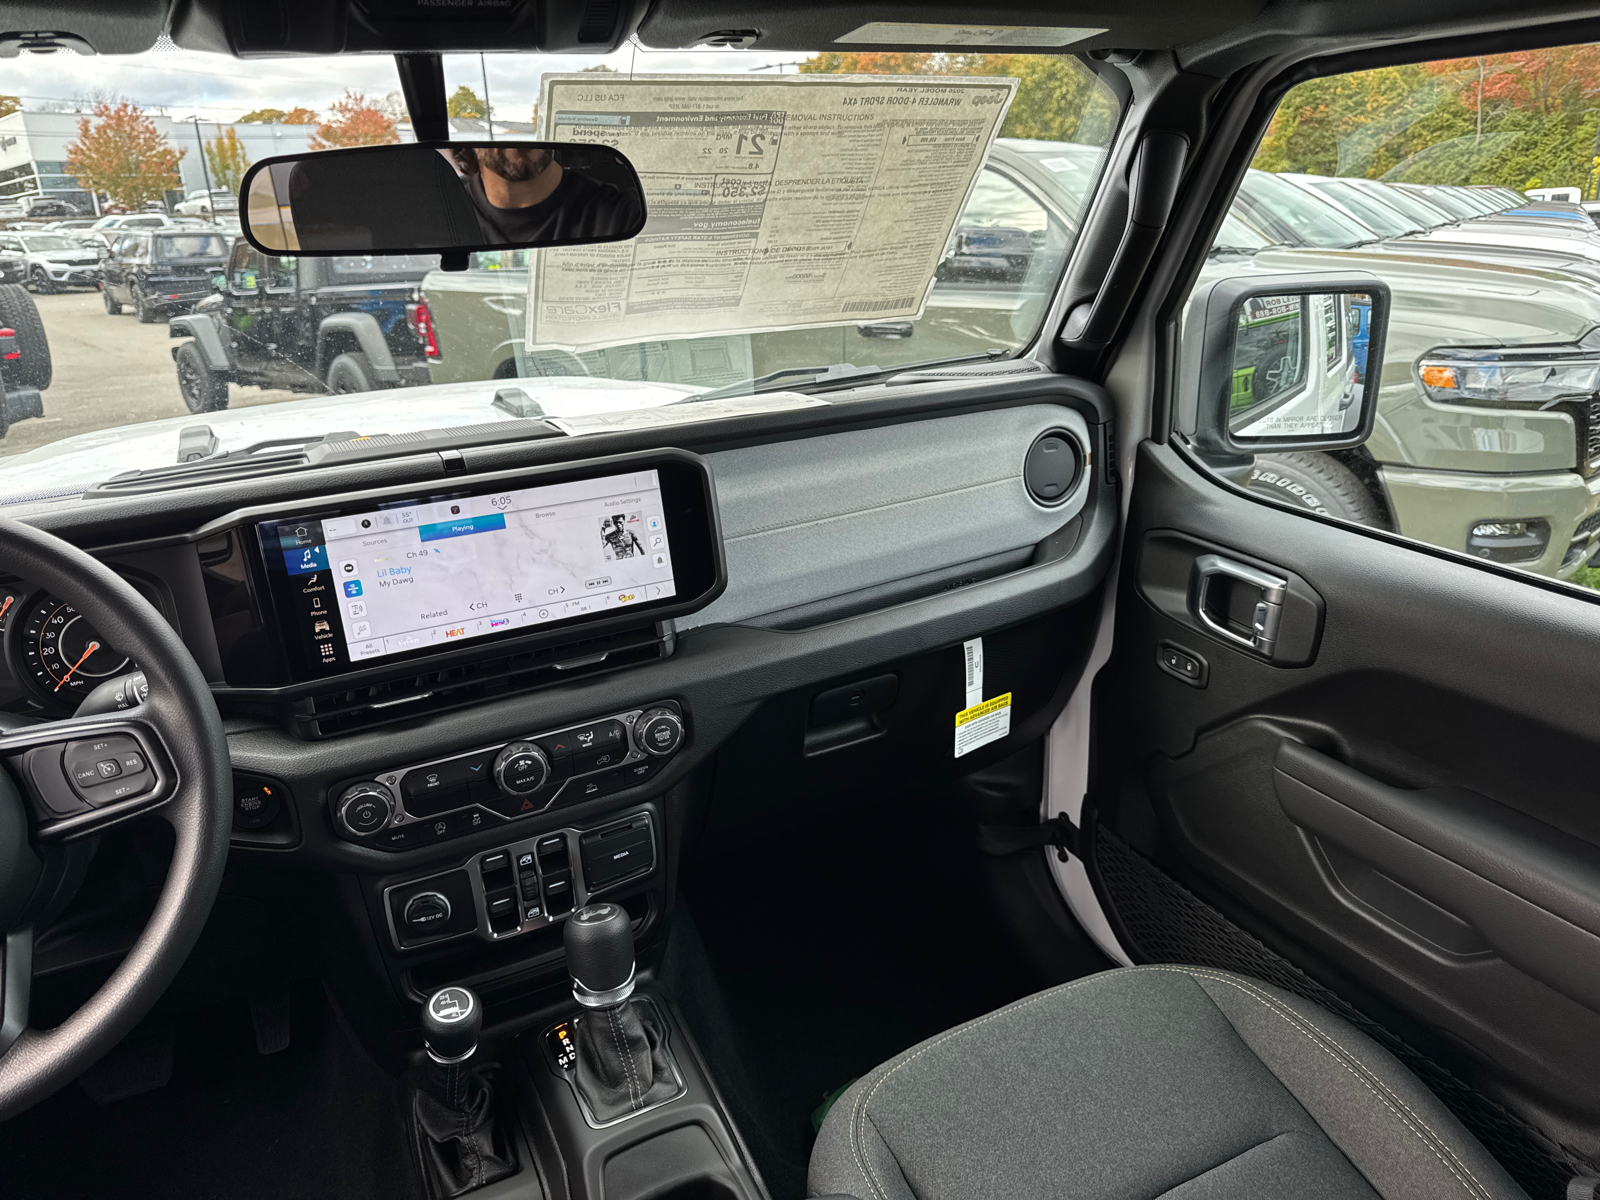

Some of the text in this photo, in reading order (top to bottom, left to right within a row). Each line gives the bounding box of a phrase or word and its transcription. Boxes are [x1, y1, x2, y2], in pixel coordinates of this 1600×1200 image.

[819, 113, 875, 121] INSTRUCTIONS
[1265, 299, 1281, 307] ROB
[491, 496, 512, 506] 6:05
[604, 497, 642, 508] Audio Settings
[535, 510, 556, 519] Browse
[452, 524, 474, 533] Playing
[362, 538, 388, 547] Sources
[406, 551, 417, 559] Ch
[377, 566, 412, 578] Lil Baby
[379, 577, 414, 589] My Dawg
[303, 585, 325, 594] Comfort
[310, 609, 328, 617] Phone
[420, 609, 448, 620] Related
[51, 615, 64, 624] 40
[314, 632, 333, 640] Vehicle
[445, 627, 465, 638] HEAT
[42, 646, 55, 656] 20
[360, 648, 380, 656] Presets
[969, 705, 985, 715] VEHICLE
[126, 759, 138, 767] RES
[77, 770, 95, 779] CANC
[613, 851, 629, 860] MEDIA
[558, 1030, 566, 1040] P
[562, 1037, 570, 1045] R
[565, 1044, 574, 1053] N
[558, 1056, 568, 1065] M
[569, 1052, 576, 1060] D
